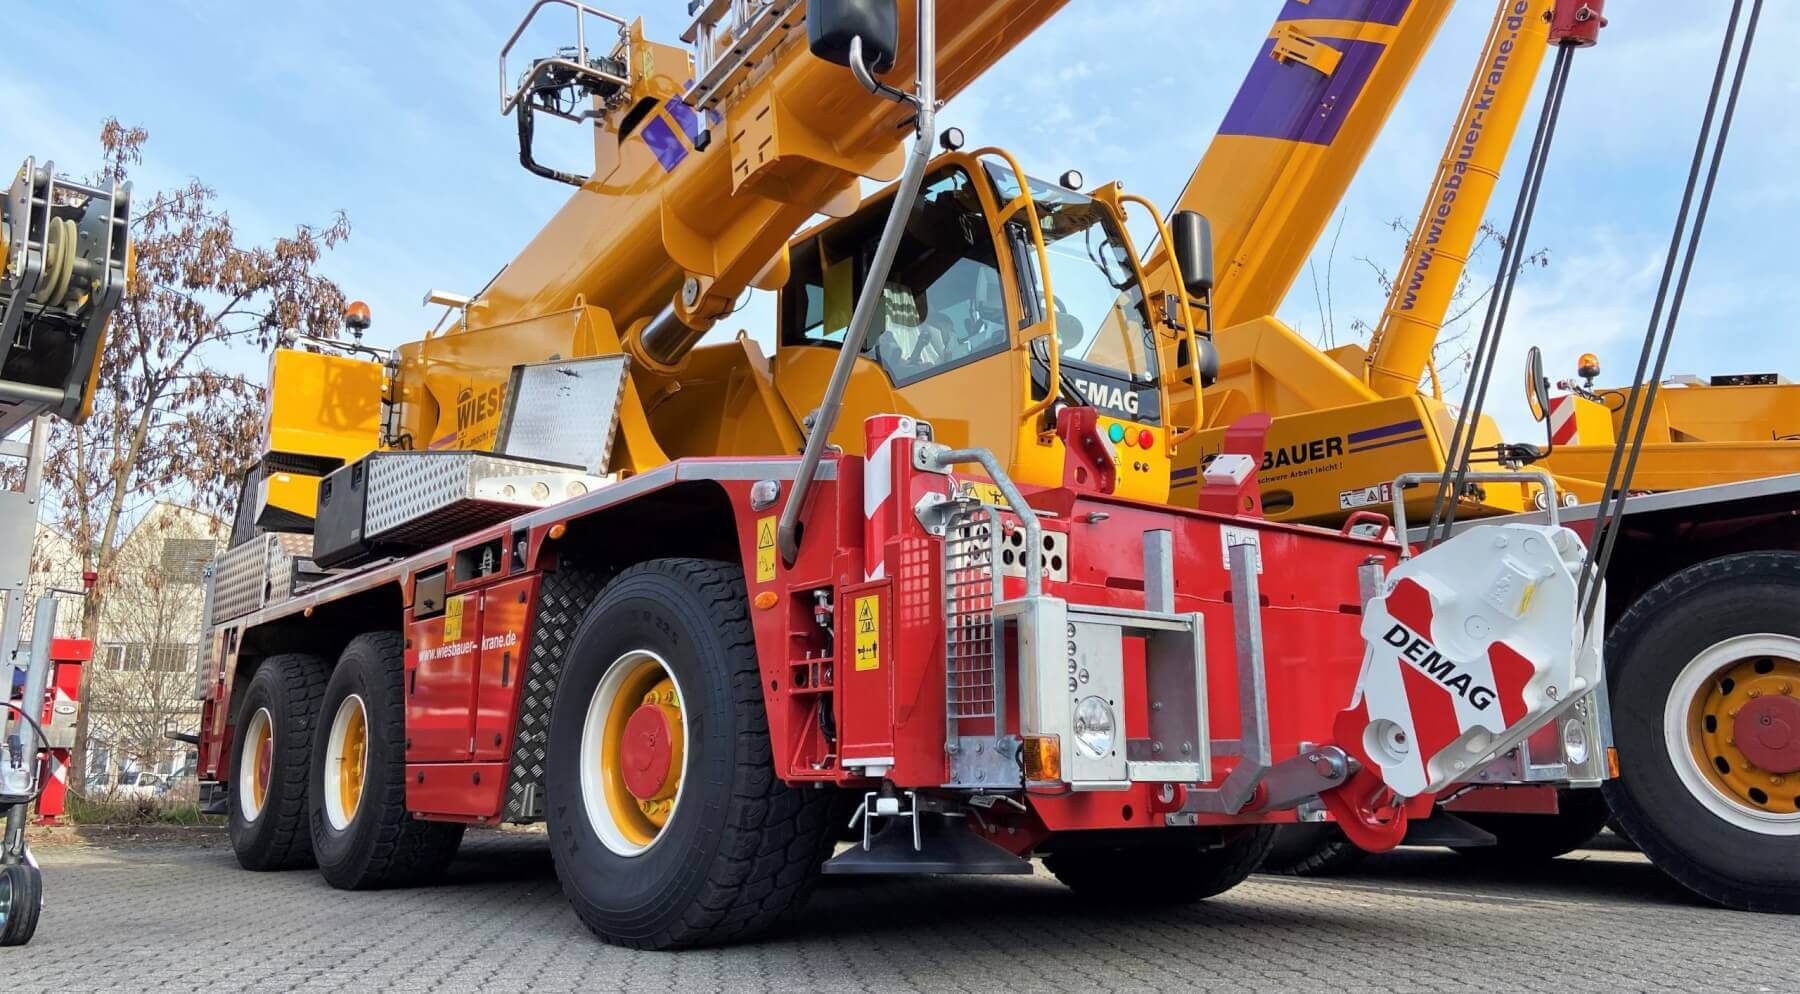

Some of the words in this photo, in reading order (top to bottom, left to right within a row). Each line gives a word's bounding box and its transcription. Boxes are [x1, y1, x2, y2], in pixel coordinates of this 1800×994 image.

[1400, 0, 1529, 311] www.wiesbauer-krane.de
[1075, 378, 1139, 414] EMAG
[1290, 468, 1313, 480] Arbeit
[1315, 463, 1338, 474] leicht
[1382, 623, 1497, 712] DEMAG
